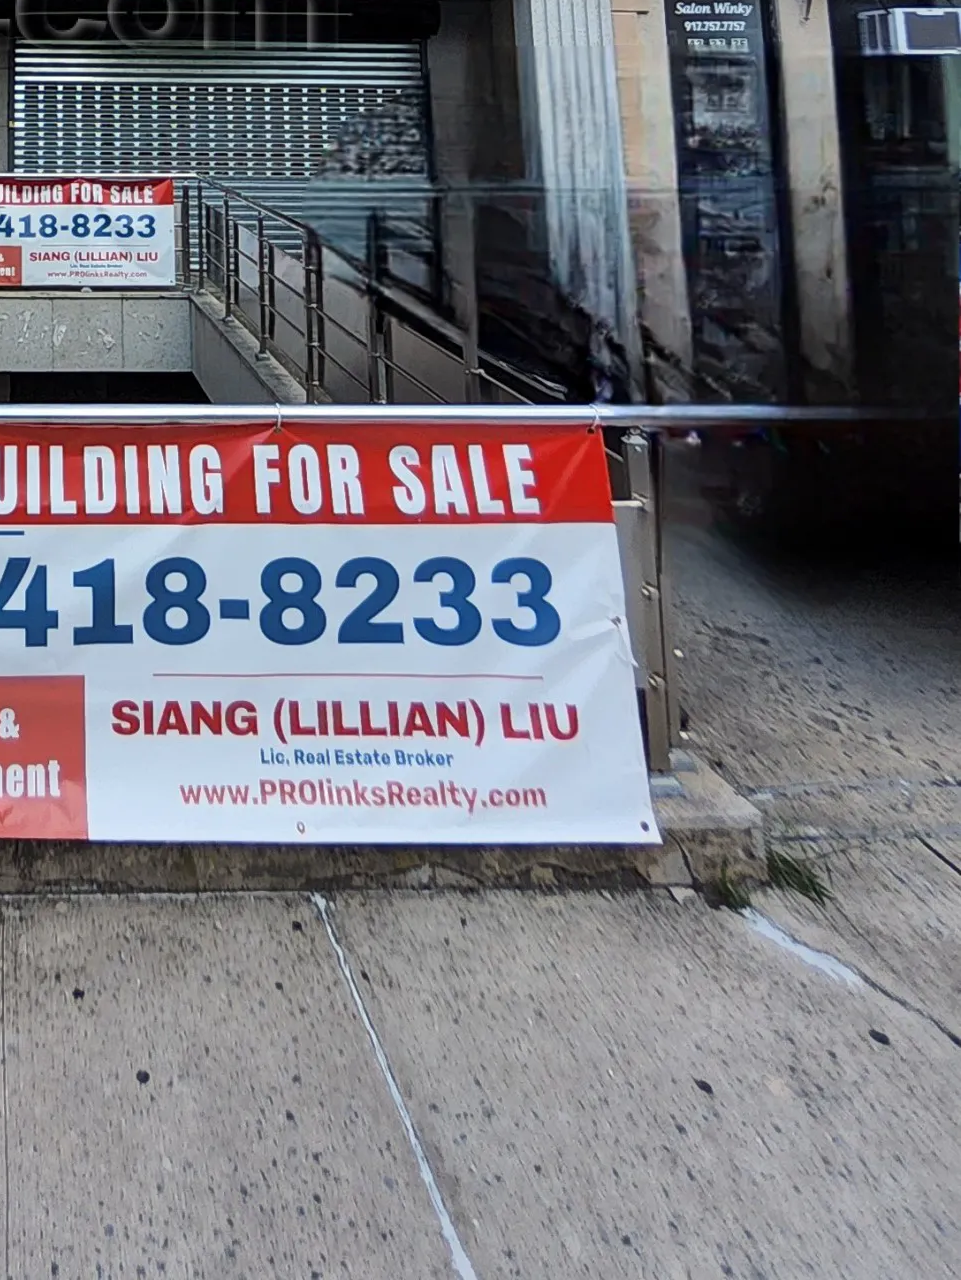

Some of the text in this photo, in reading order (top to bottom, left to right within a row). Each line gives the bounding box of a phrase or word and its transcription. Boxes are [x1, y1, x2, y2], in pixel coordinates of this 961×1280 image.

[674, 1, 754, 17] Salon Winky
[71, 183, 104, 204] FOR
[110, 183, 155, 205] SALE
[29, 251, 159, 263] SIANG (LILLIAN) LIU
[253, 443, 365, 517] FOR
[389, 443, 541, 517] SALE
[111, 697, 581, 747] SIANG (LILLIAN) LIU
[294, 748, 331, 766] Real
[334, 748, 391, 766] Estate
[394, 748, 455, 768] Broker
[179, 777, 548, 816] www.PROlinksRealty.com
